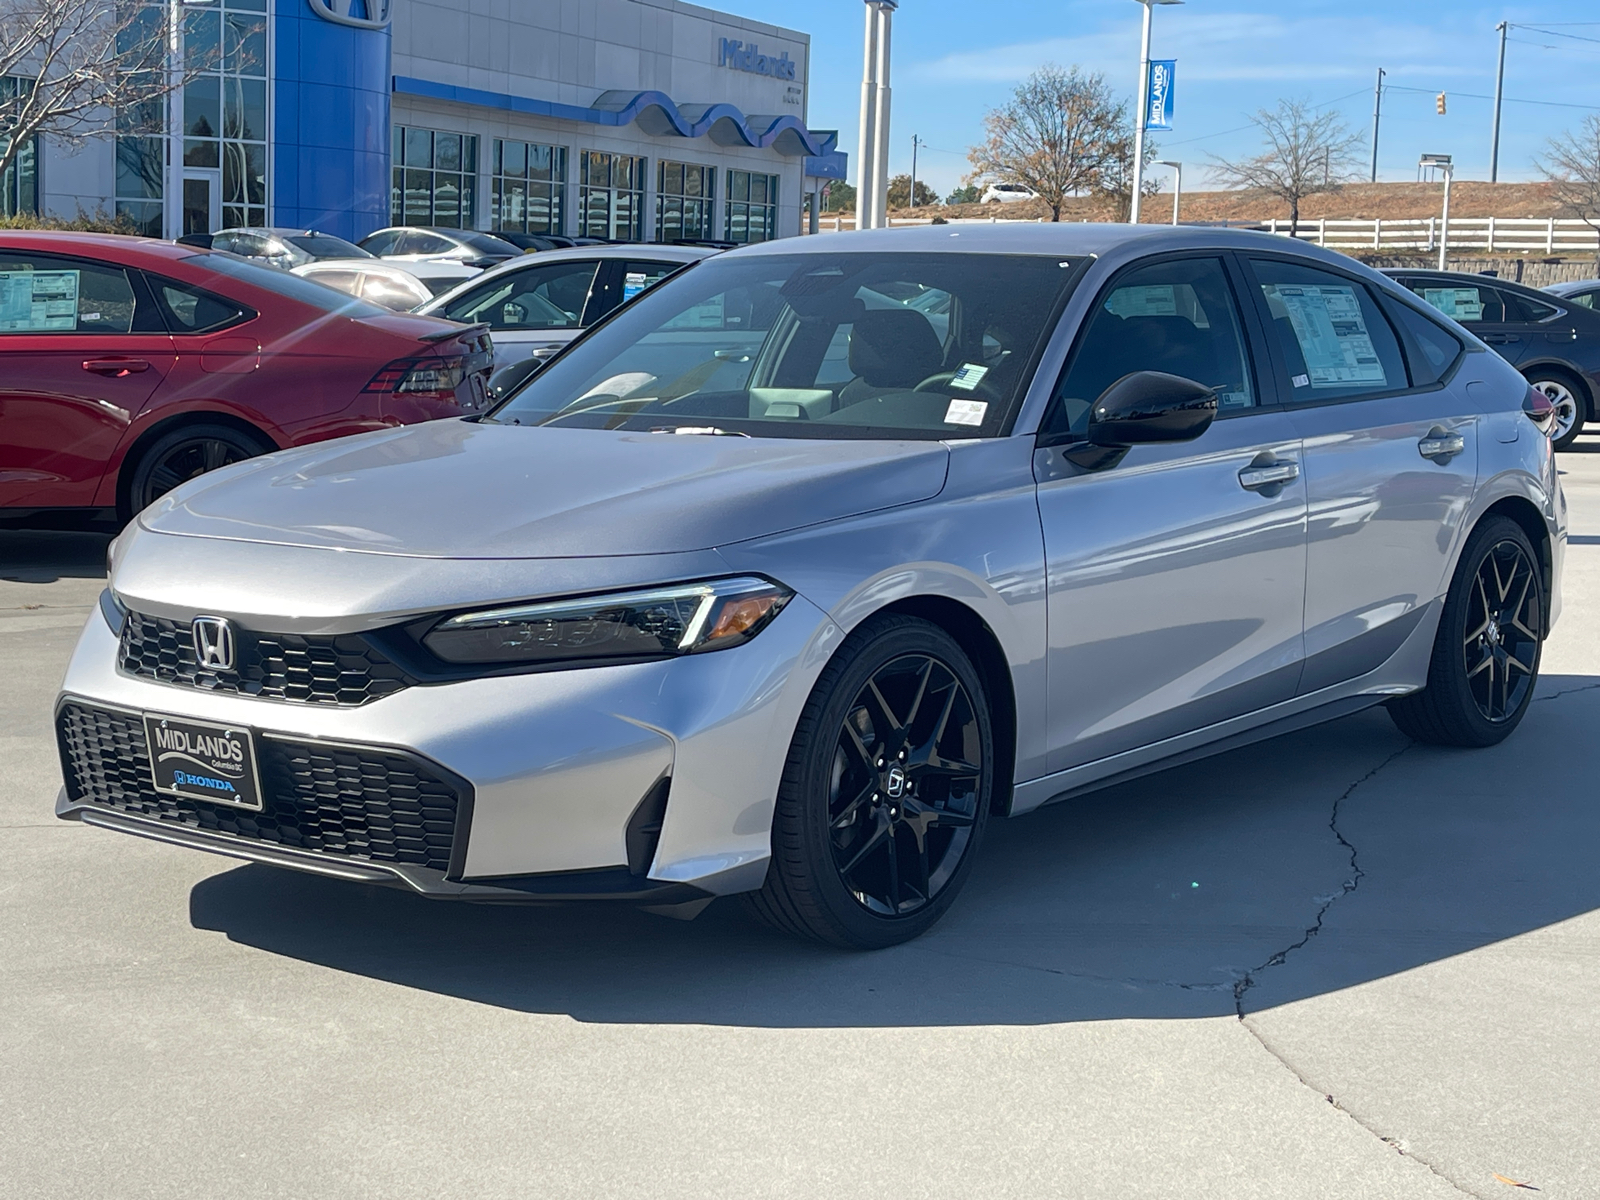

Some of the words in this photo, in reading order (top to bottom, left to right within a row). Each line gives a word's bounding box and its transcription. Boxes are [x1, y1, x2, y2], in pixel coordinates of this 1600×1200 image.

[718, 37, 795, 80] Midlands
[1151, 65, 1163, 124] MIDLANDS
[155, 728, 243, 761] MIDLANDS
[186, 774, 235, 792] HONDA
